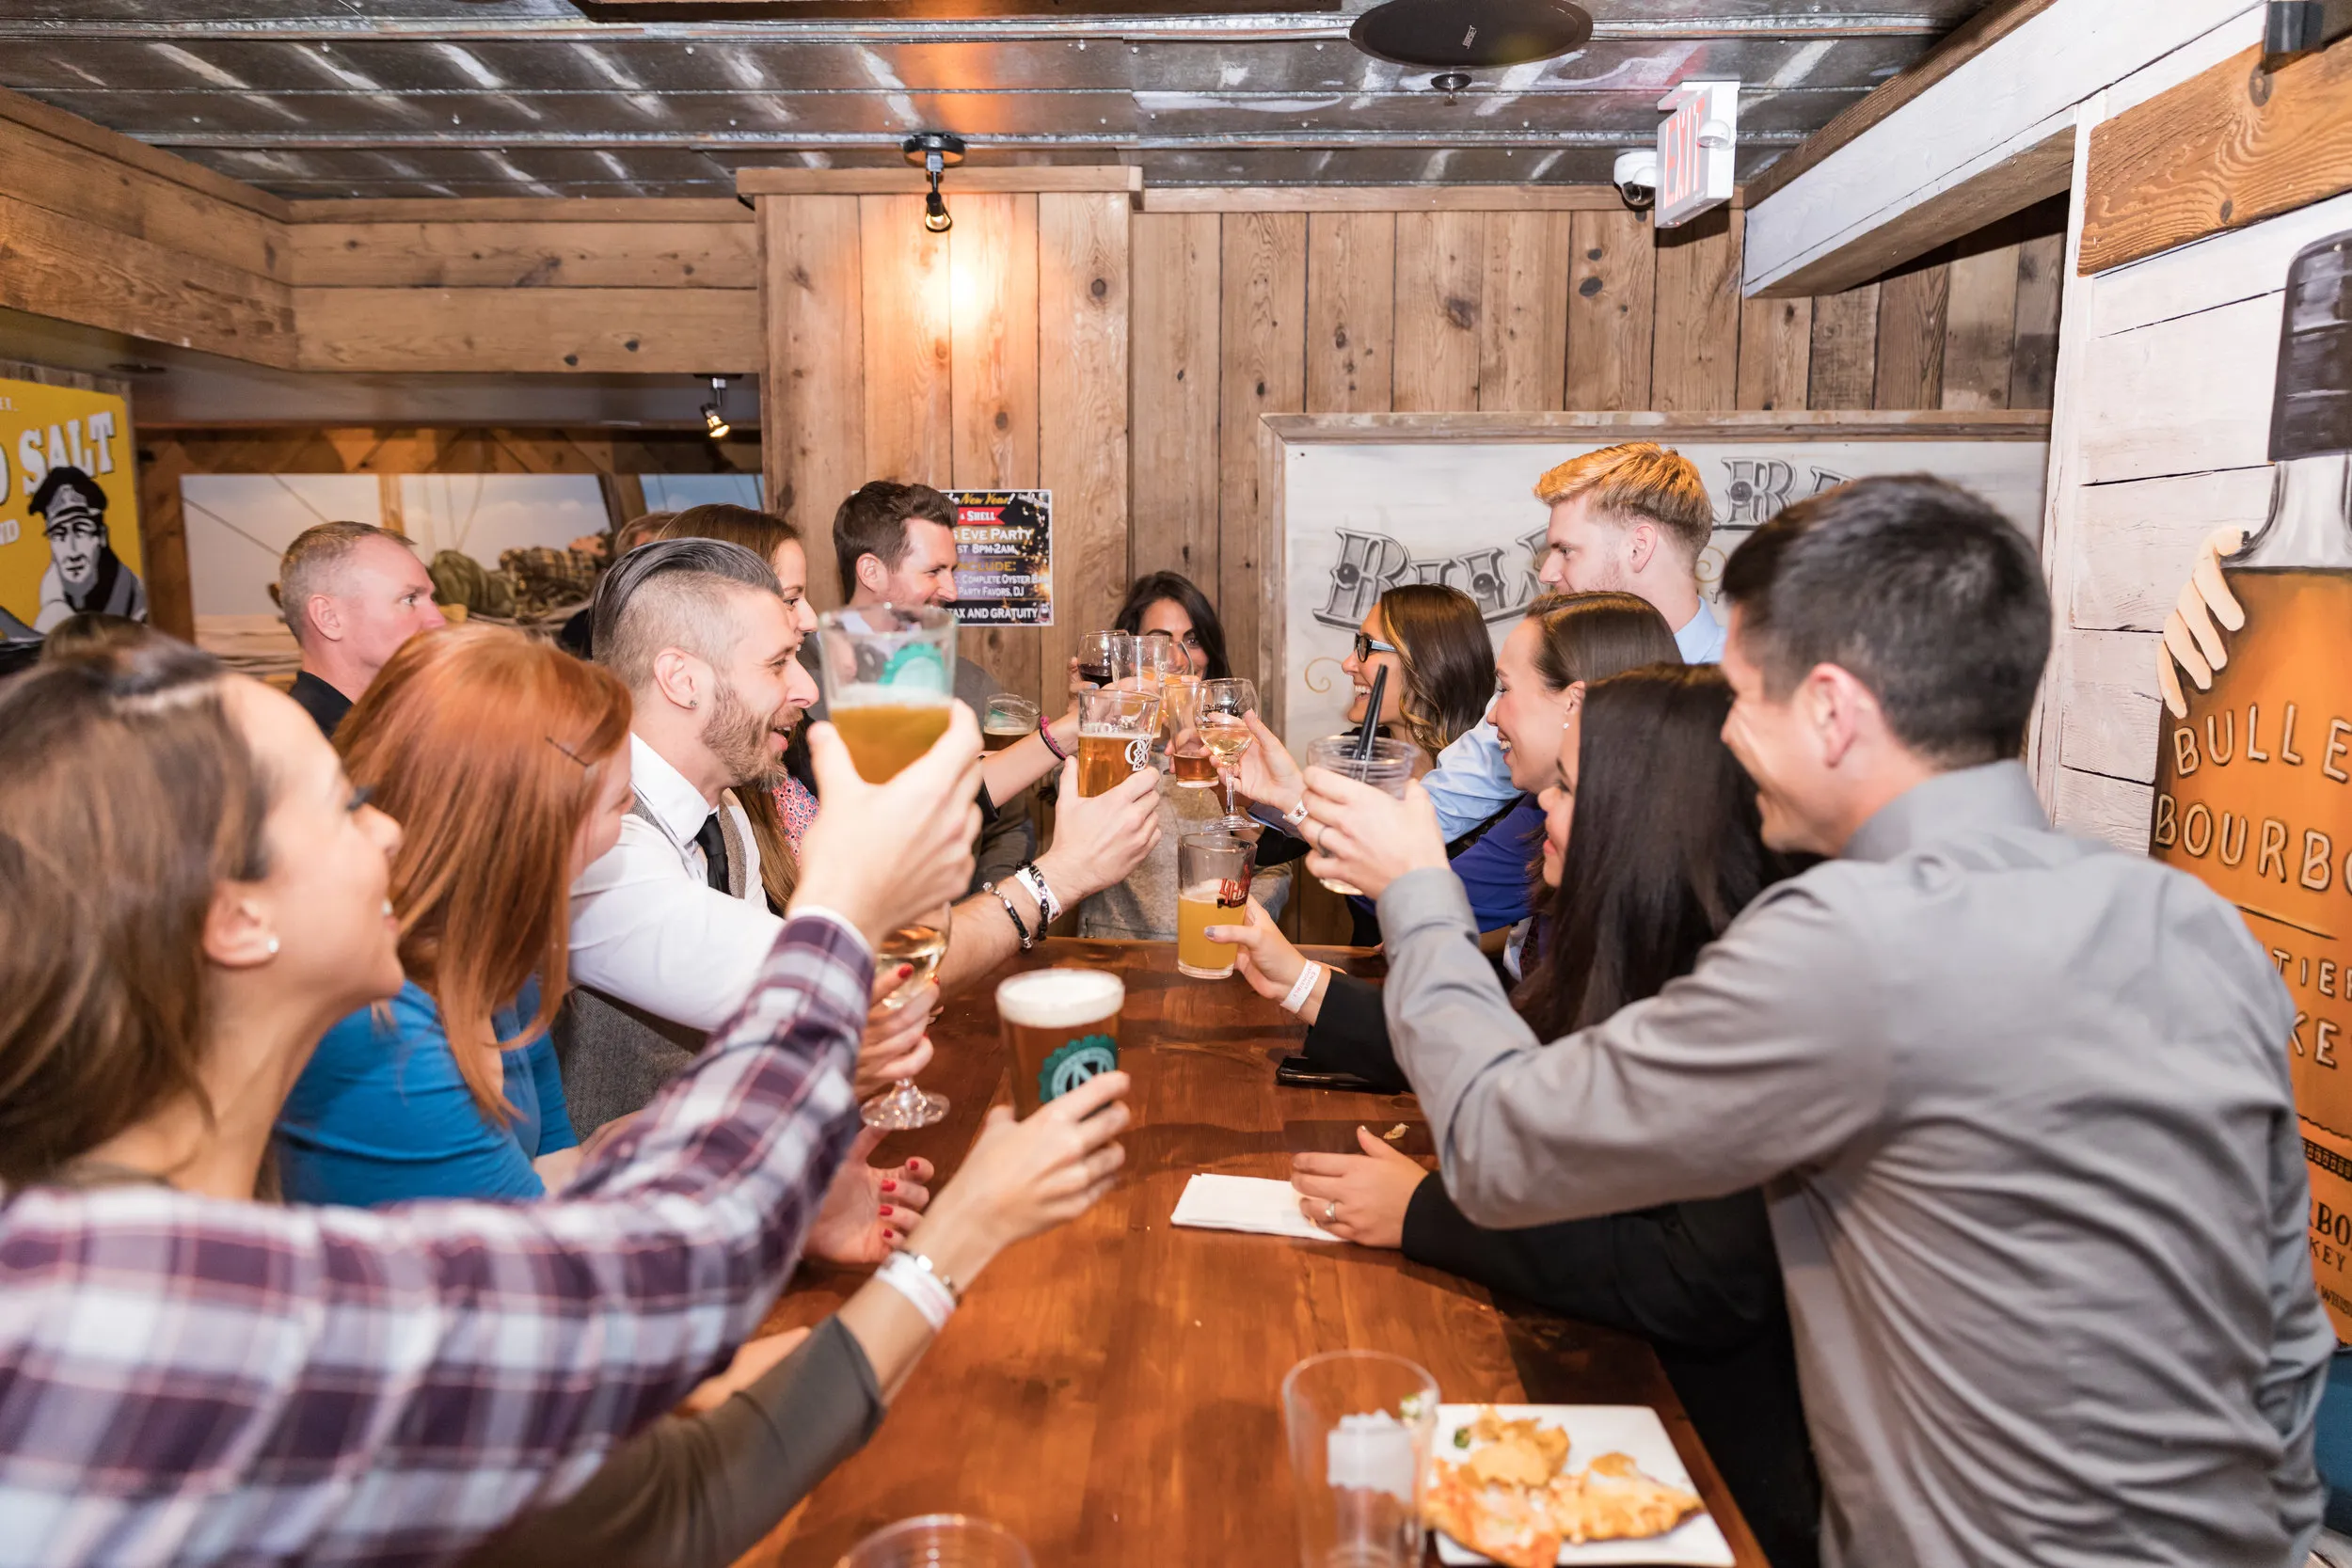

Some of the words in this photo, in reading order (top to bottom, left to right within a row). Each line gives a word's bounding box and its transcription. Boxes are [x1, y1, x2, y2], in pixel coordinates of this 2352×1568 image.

[1663, 97, 1706, 209] EXIT
[19, 411, 115, 496] SALT
[966, 510, 996, 522] SHELL
[961, 528, 988, 541] EVE
[991, 527, 1034, 541] PARTY
[1001, 573, 1030, 584] OYSTER
[1012, 585, 1025, 597] DJ
[966, 607, 990, 619] AND
[990, 607, 1039, 620] GRATUITY
[2173, 702, 2352, 784] BULLE
